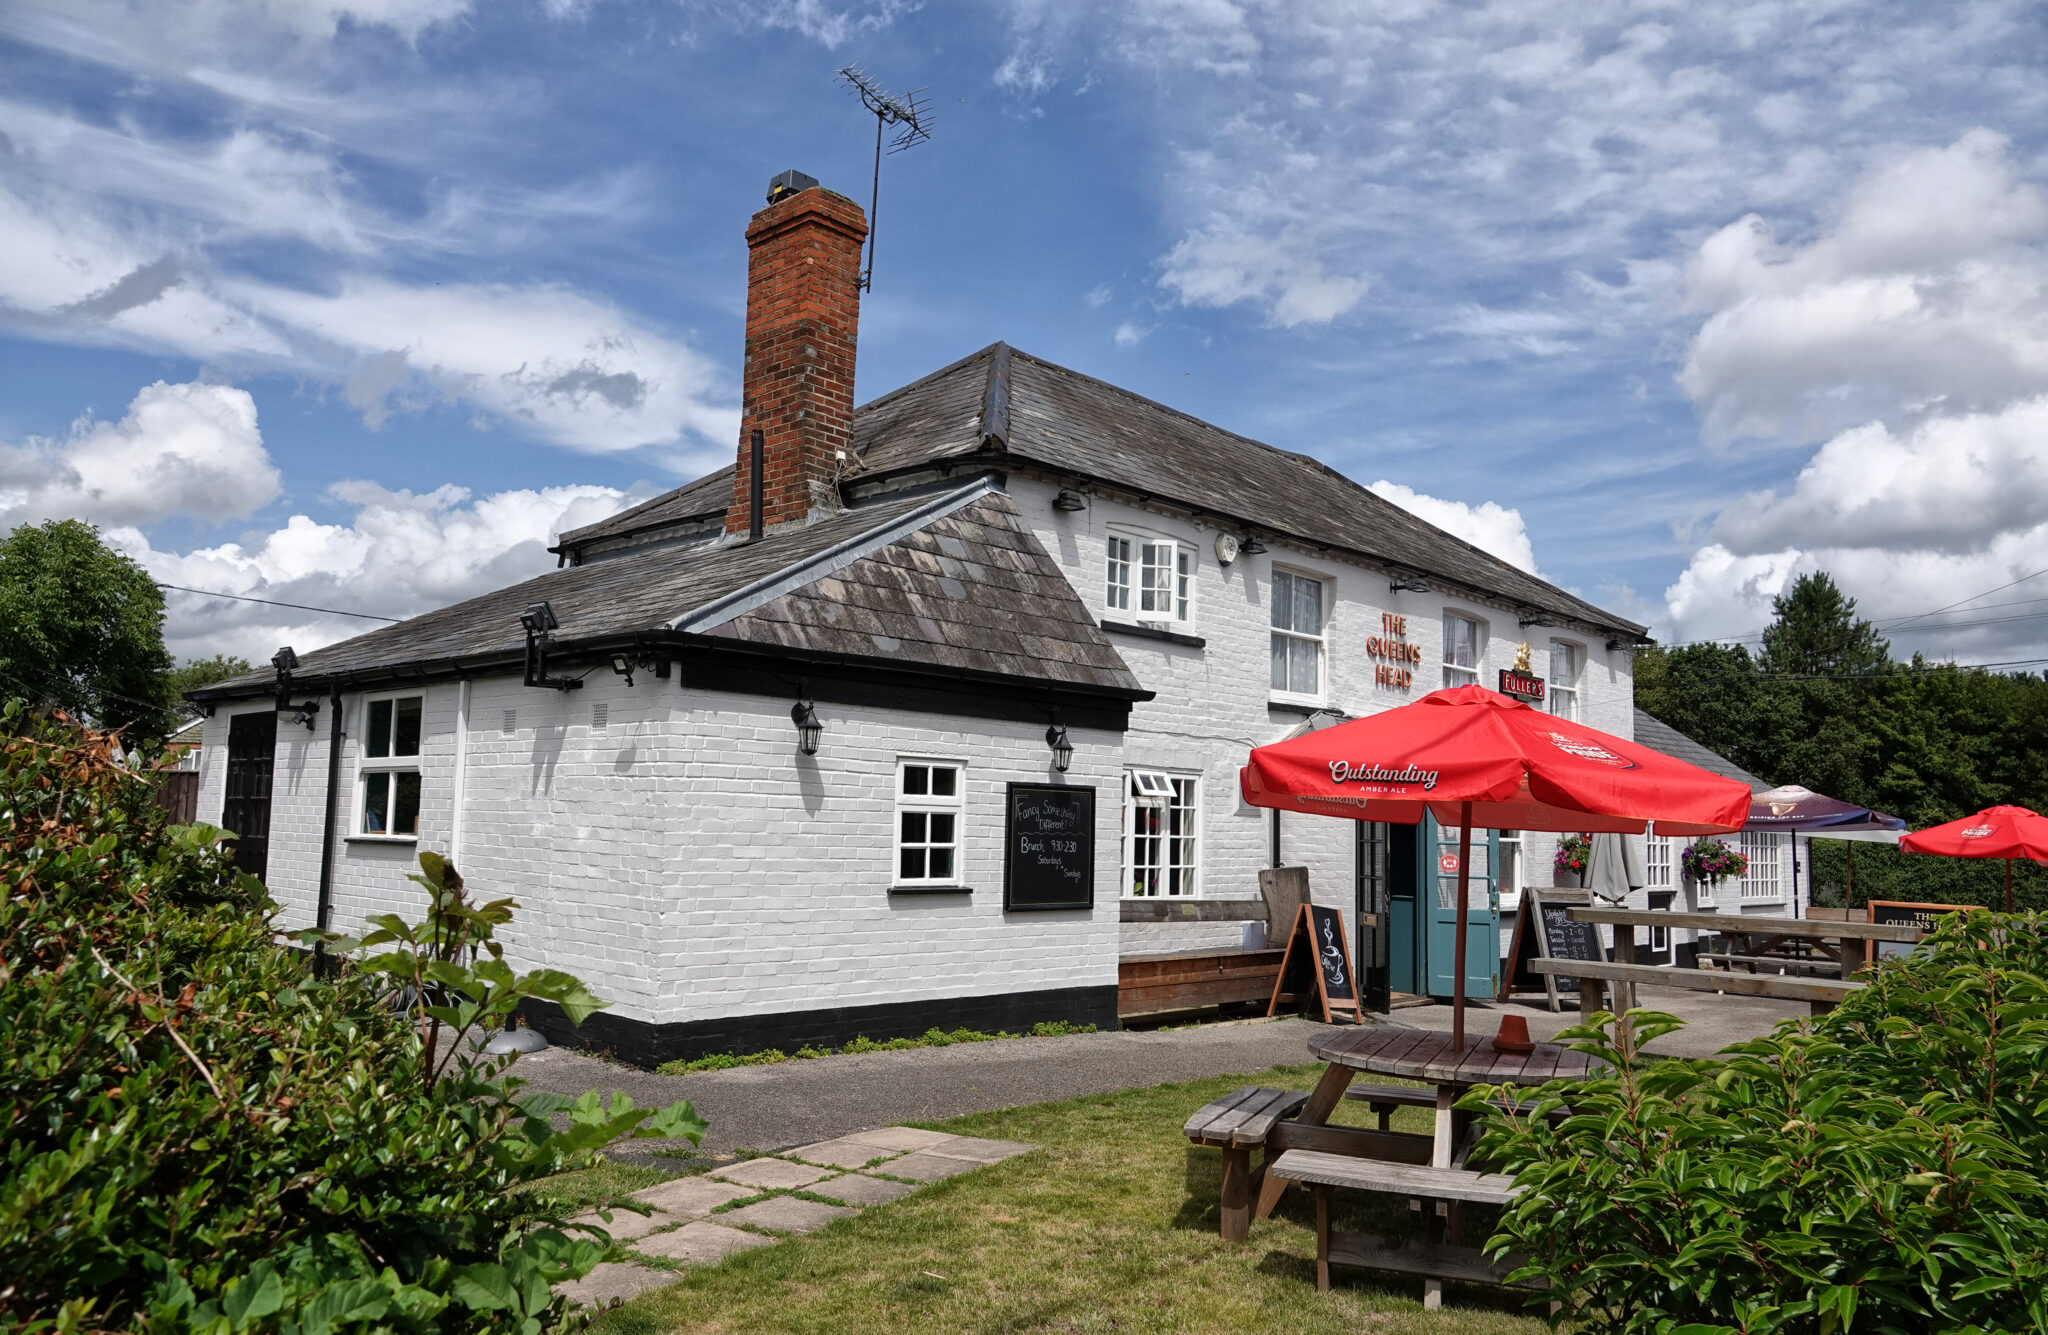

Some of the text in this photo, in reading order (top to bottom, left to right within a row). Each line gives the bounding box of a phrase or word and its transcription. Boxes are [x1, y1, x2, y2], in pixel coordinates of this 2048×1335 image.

[1382, 612, 1406, 635] THE
[1367, 635, 1421, 664] QUEENS
[1375, 664, 1412, 688] HEAD
[1328, 760, 1439, 791] Outstanding
[1016, 800, 1075, 822] Fancy Something
[1039, 819, 1067, 831] Different?
[1886, 919, 1931, 930] QUEENS
